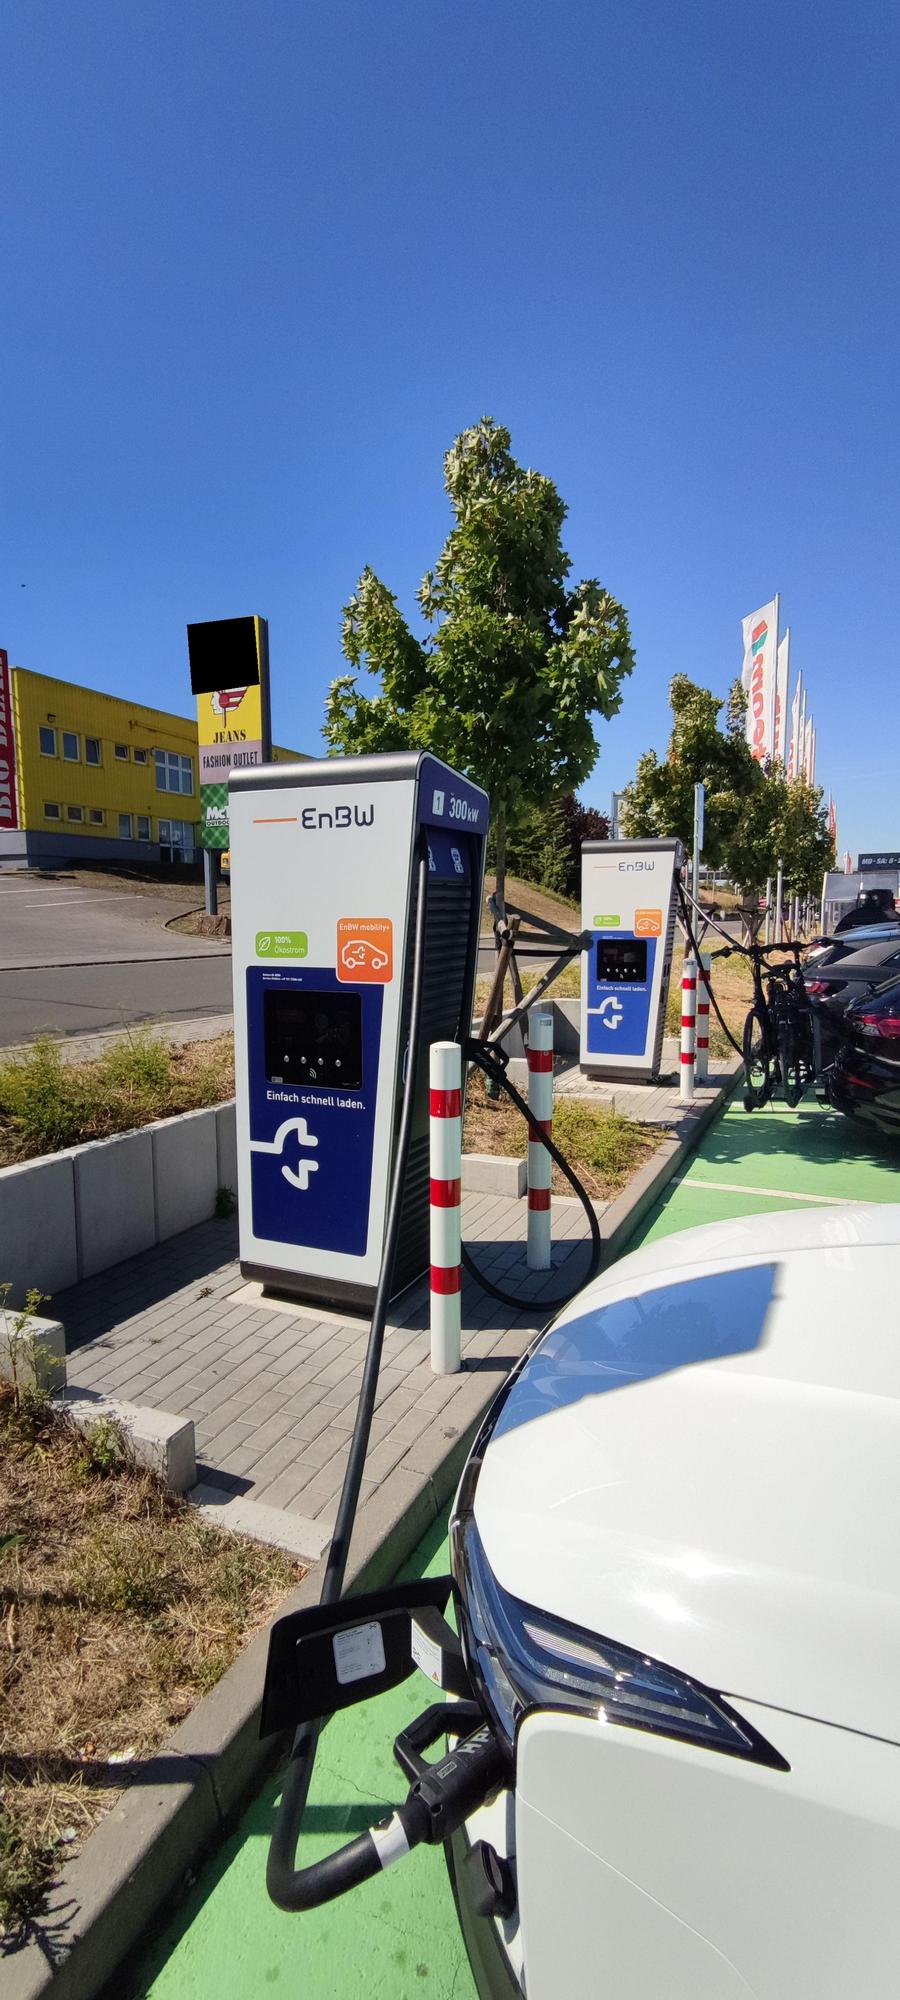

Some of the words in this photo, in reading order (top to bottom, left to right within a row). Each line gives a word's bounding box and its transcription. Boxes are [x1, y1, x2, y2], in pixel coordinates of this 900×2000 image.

[213, 729, 246, 743] JEANS
[203, 754, 231, 769] FASHION
[233, 752, 258, 766] OUTLET
[302, 804, 374, 829] EnBW
[618, 861, 655, 872] EnBW
[339, 923, 359, 931] EnBW
[360, 922, 390, 933] mobility+
[274, 936, 292, 944] 100%
[274, 945, 305, 954] Ökostrom
[266, 1090, 299, 1103] Einfach
[301, 1094, 334, 1107] schnell
[336, 1096, 366, 1110] laden.
